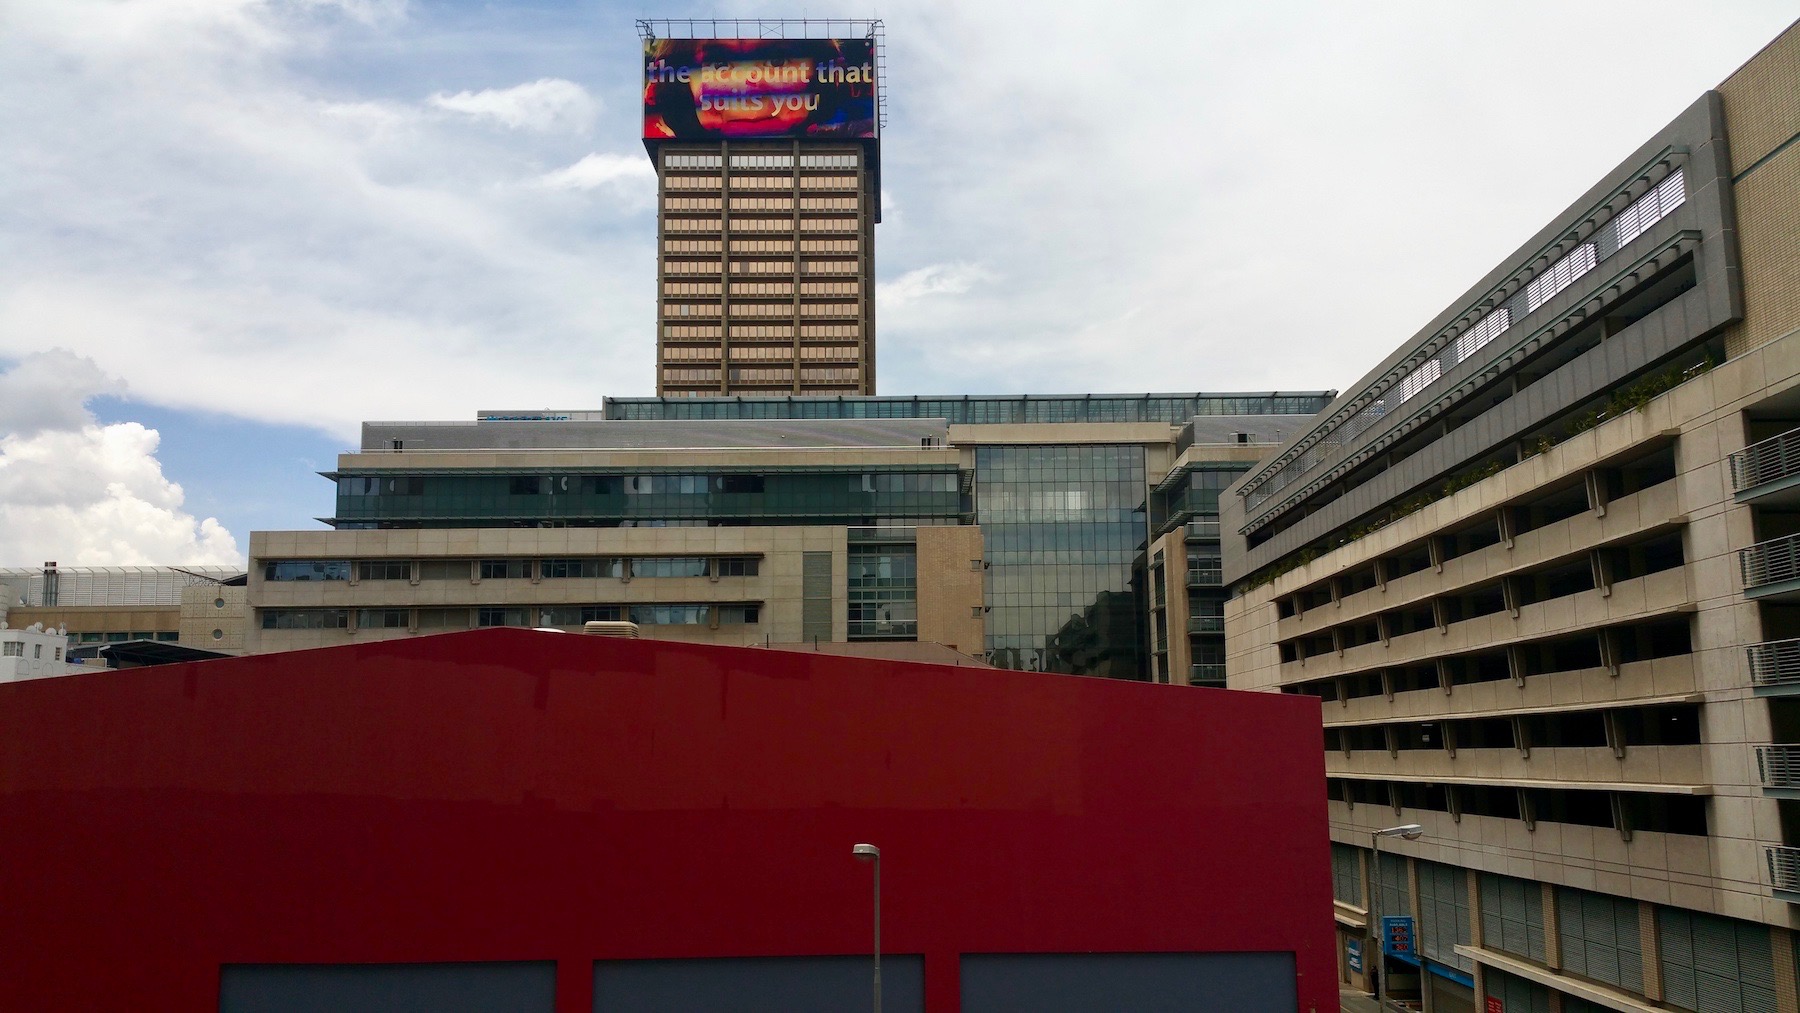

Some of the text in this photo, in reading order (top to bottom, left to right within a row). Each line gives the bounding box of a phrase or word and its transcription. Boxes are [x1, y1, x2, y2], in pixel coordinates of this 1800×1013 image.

[646, 59, 872, 83] the account that
[700, 88, 820, 117] suits you
